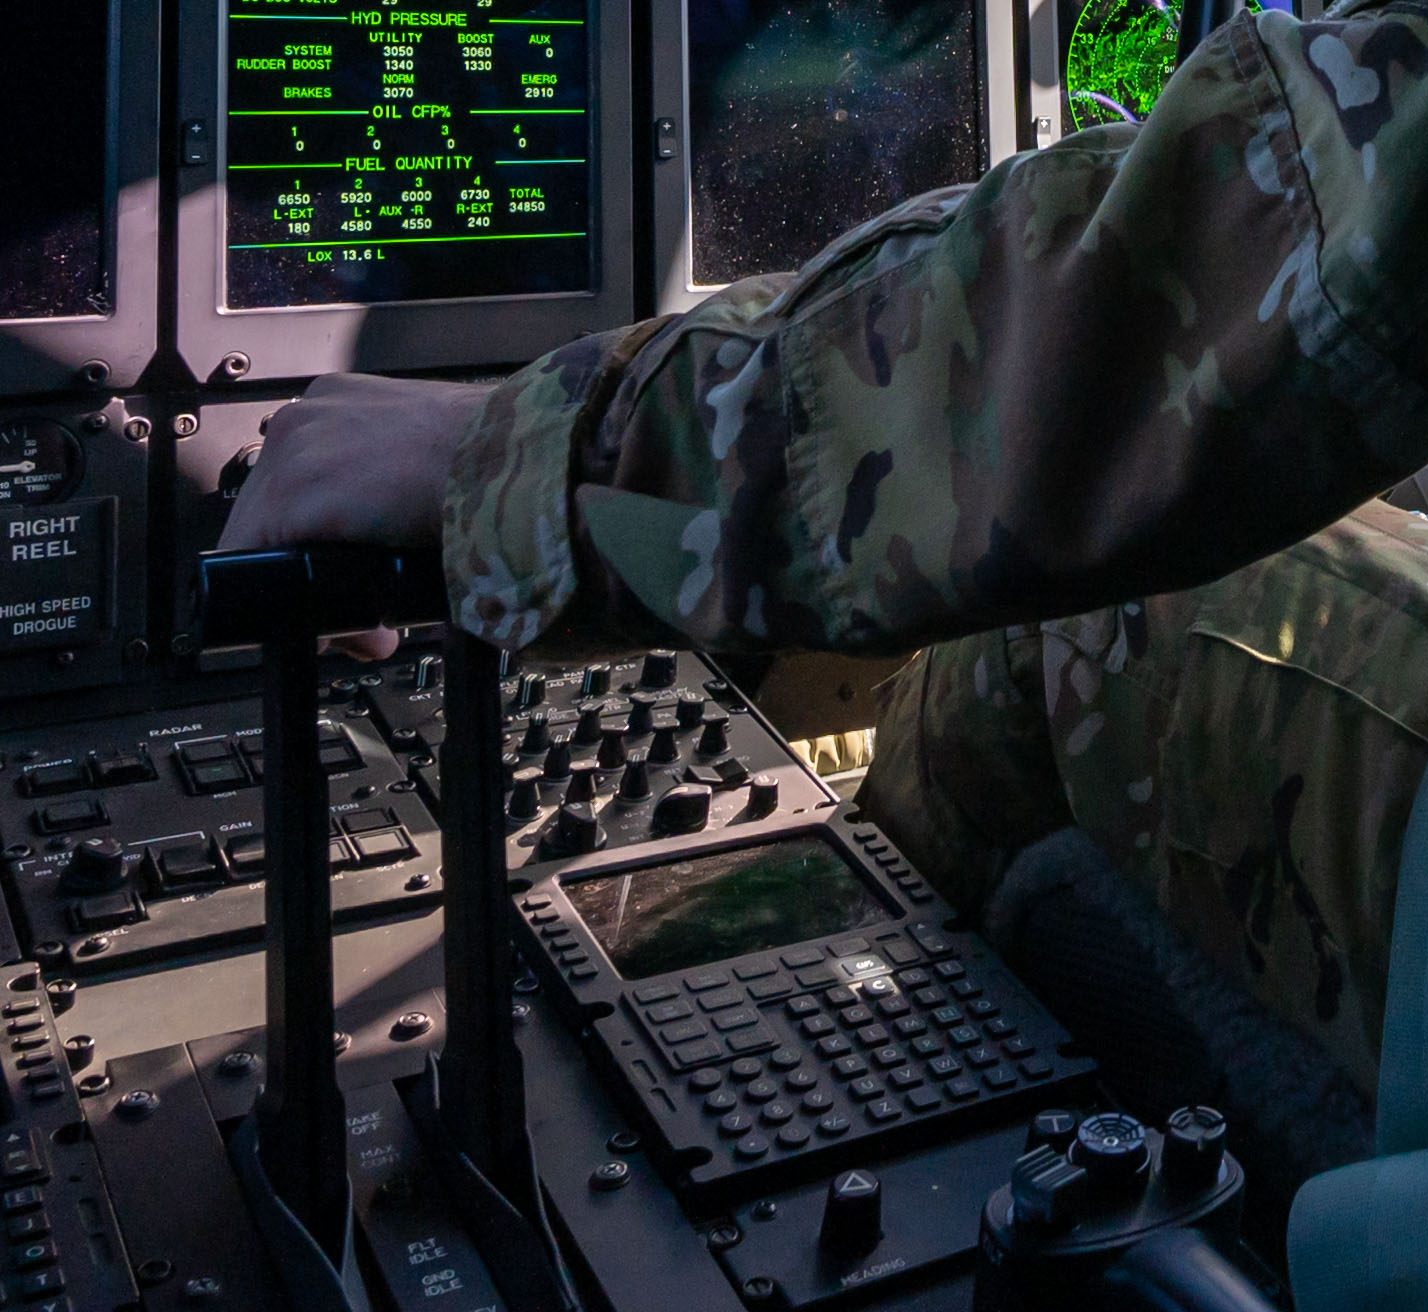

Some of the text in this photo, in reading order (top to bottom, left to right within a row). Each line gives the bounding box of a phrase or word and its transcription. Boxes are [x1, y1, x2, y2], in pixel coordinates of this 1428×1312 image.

[352, 11, 467, 26] HYD PRESSURE
[370, 32, 550, 44] UTILITY BOOST AUX
[1080, 33, 1094, 45] 33
[285, 45, 491, 57] SYSTEM 3050 3060
[237, 59, 491, 70] RUDDER BOOST 1340 1330
[383, 74, 557, 84] NORM EMERG
[284, 87, 553, 98] BRAKES 3070 2910
[373, 105, 401, 118] OIL
[346, 156, 472, 171] FUEL QUANTITY
[278, 188, 544, 205] 6650 5920 6000 6730 TOTAL
[274, 201, 545, 219] L-EXT AUX R-EXT 34850
[288, 217, 490, 234] 180 4580 4550 240
[308, 249, 371, 262] LOX 13.6
[13, 472, 63, 486] ELEVATOR
[26, 483, 51, 493] TRIM
[9, 515, 81, 538] RIGHT
[11, 540, 77, 561] REEL
[0, 595, 91, 619] HIGH SPEED
[13, 616, 77, 636] DROGUE
[149, 723, 203, 737] RADAR
[219, 821, 253, 832] GAIN
[351, 1121, 382, 1136] OFF
[407, 1237, 436, 1254] FLT
[408, 1246, 449, 1265] IDLE
[421, 1269, 456, 1286] GND
[424, 1277, 464, 1298] IDLE
